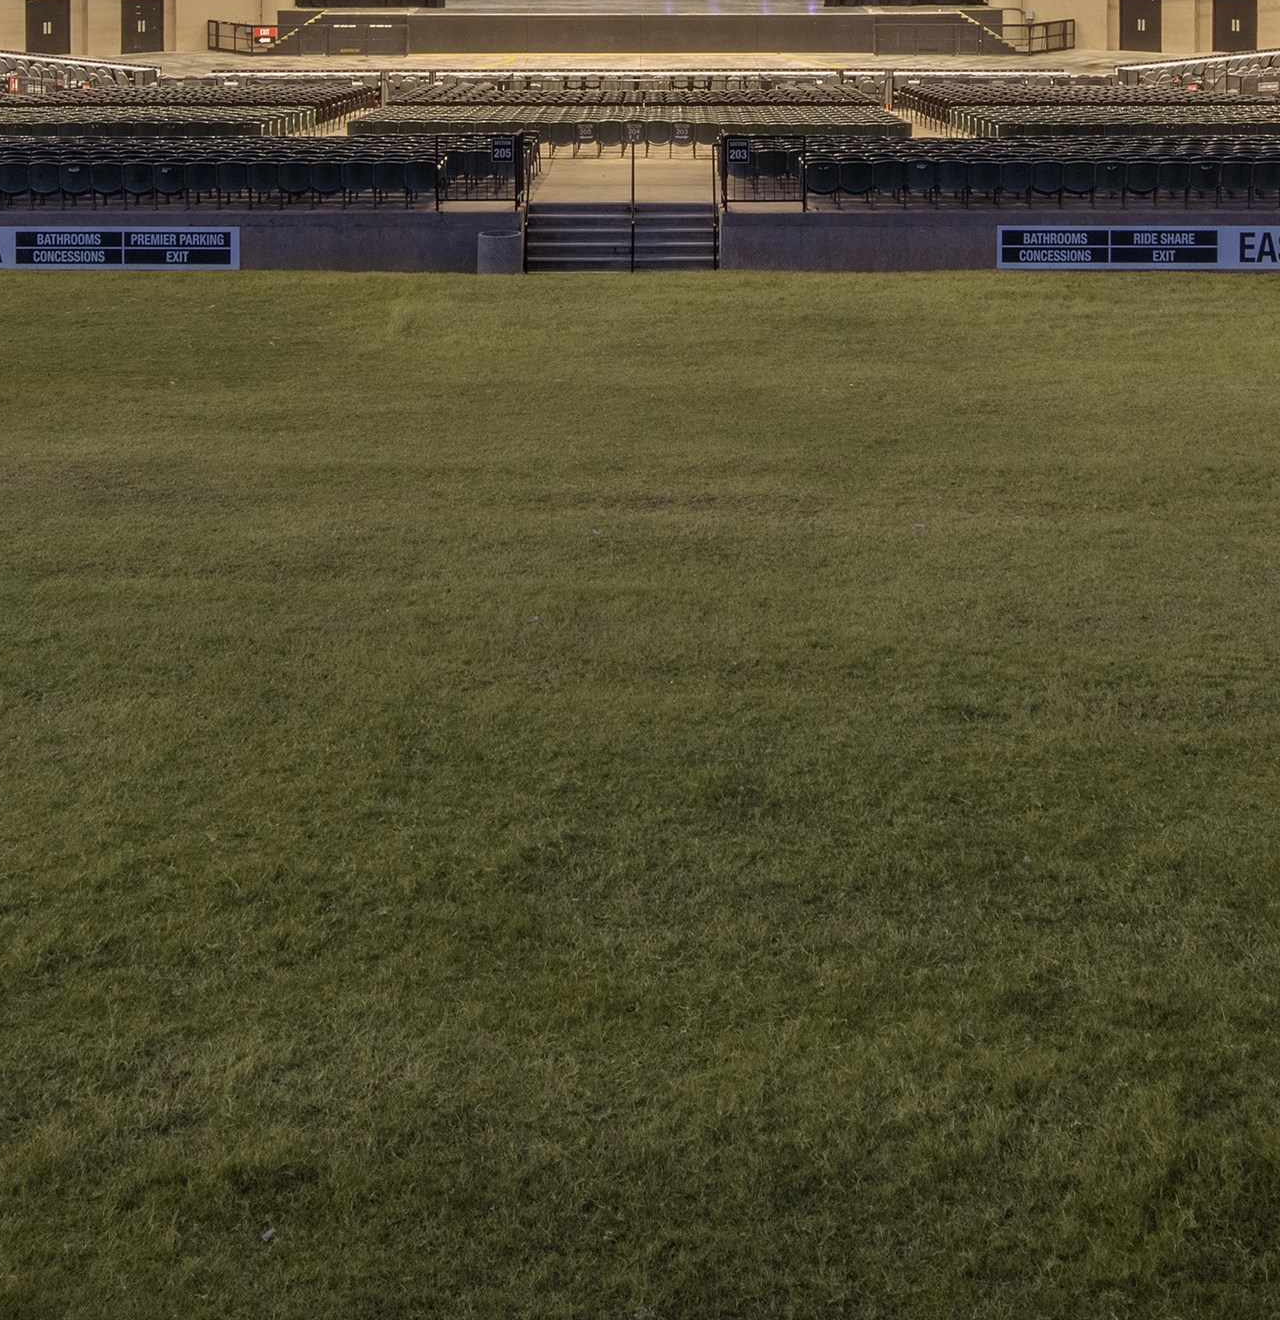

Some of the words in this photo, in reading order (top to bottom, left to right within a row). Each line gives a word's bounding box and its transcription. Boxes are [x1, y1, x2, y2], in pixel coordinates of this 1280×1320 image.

[493, 148, 512, 159] 205
[729, 149, 747, 160] 203
[37, 233, 101, 246] BATHROOMS
[130, 233, 177, 246] PREMIER
[179, 233, 225, 247] PARKING
[1023, 232, 1088, 245] BATHROOMS
[1133, 232, 1158, 245] RIDE
[1160, 232, 1195, 245] SHARE
[33, 250, 105, 264] CONCESSIONS
[165, 251, 189, 263] EXIT
[1019, 249, 1091, 262] CONCESSIONS
[1152, 250, 1176, 262] EXIT
